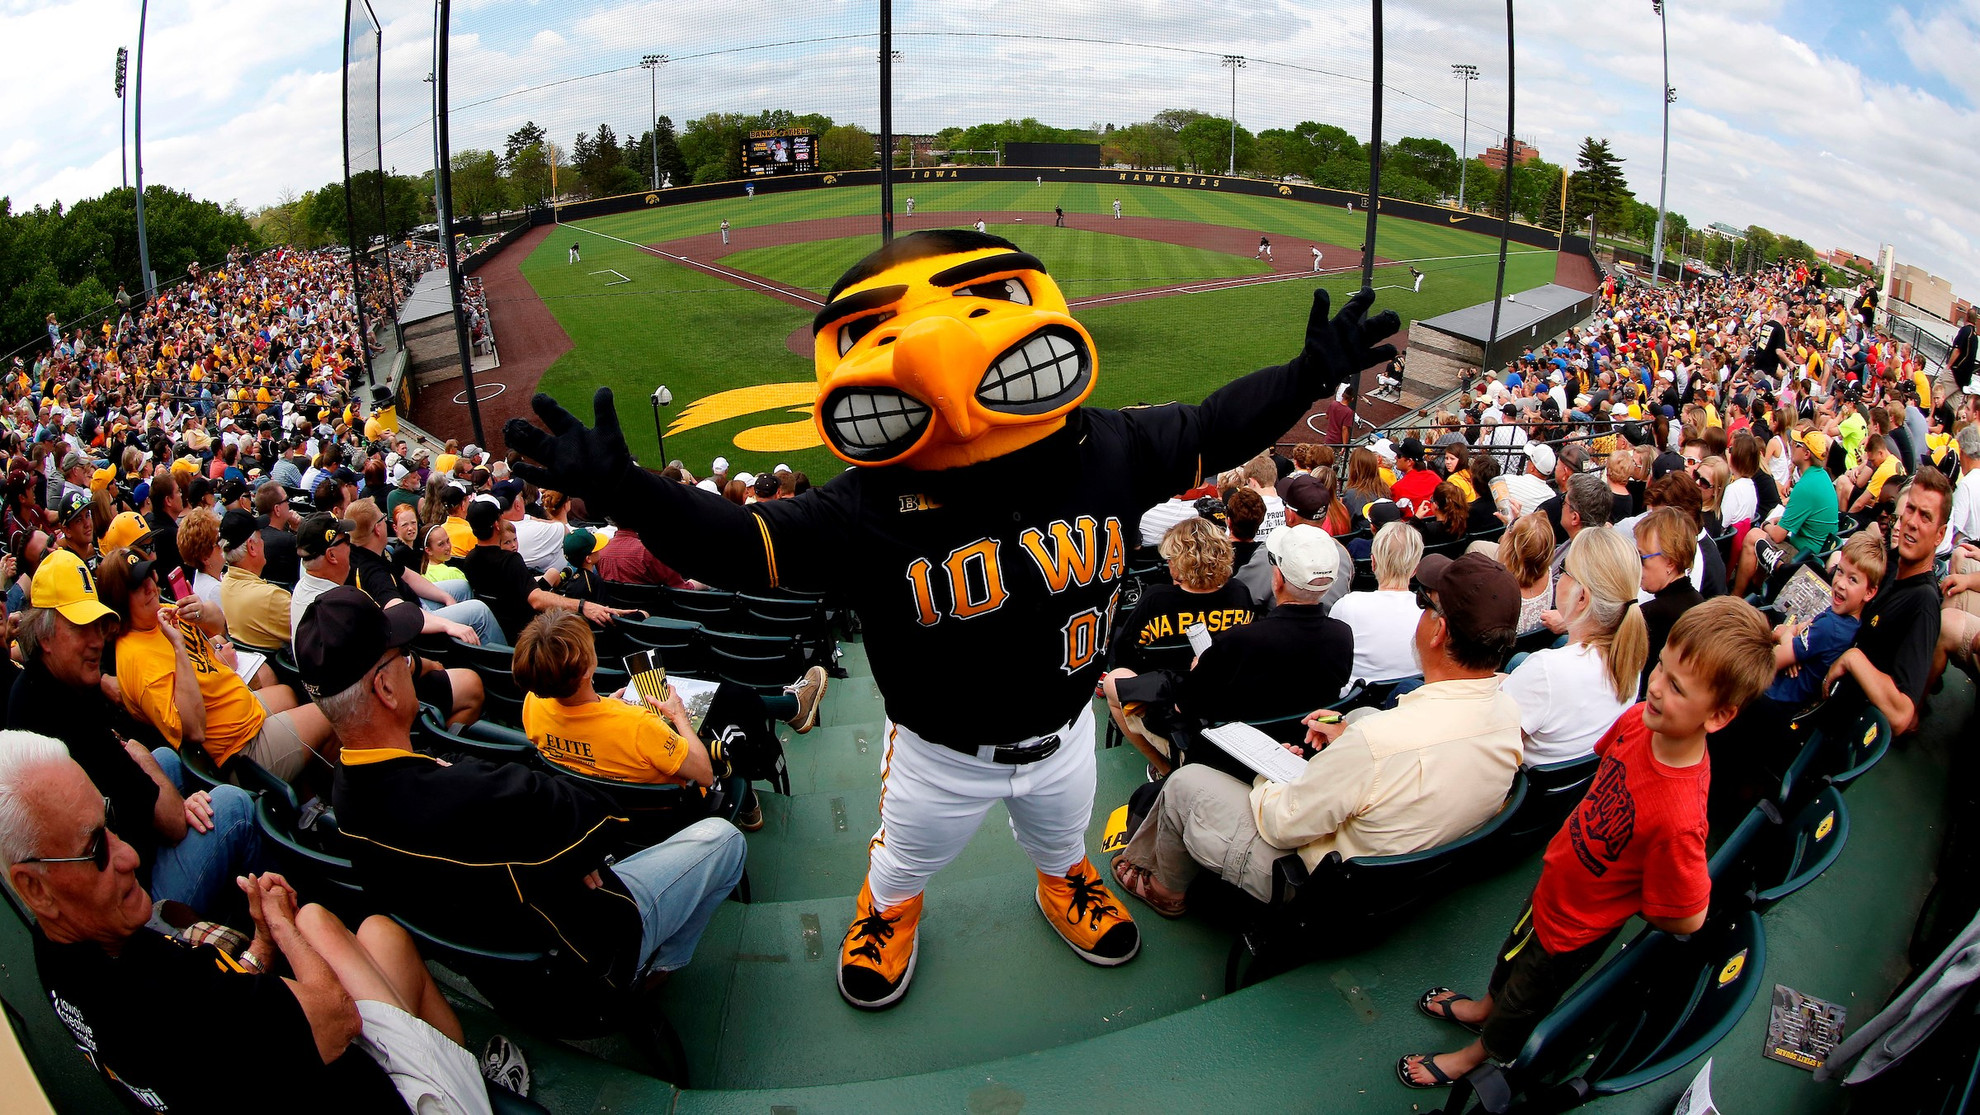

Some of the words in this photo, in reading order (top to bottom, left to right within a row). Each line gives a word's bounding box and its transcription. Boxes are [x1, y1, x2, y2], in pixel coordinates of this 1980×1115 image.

[750, 130, 776, 139] BANKS
[789, 128, 811, 136] FIELD
[911, 171, 957, 179] IOWA
[1118, 173, 1221, 187] HAWKEYES
[133, 515, 145, 529] I
[1267, 511, 1286, 520] PROU
[77, 565, 94, 594] I
[906, 515, 1125, 627] IOWA
[1178, 609, 1255, 635] BASEBA
[545, 733, 594, 758] ELITE
[663, 730, 679, 751] ELI
[1101, 831, 1127, 852] HA
